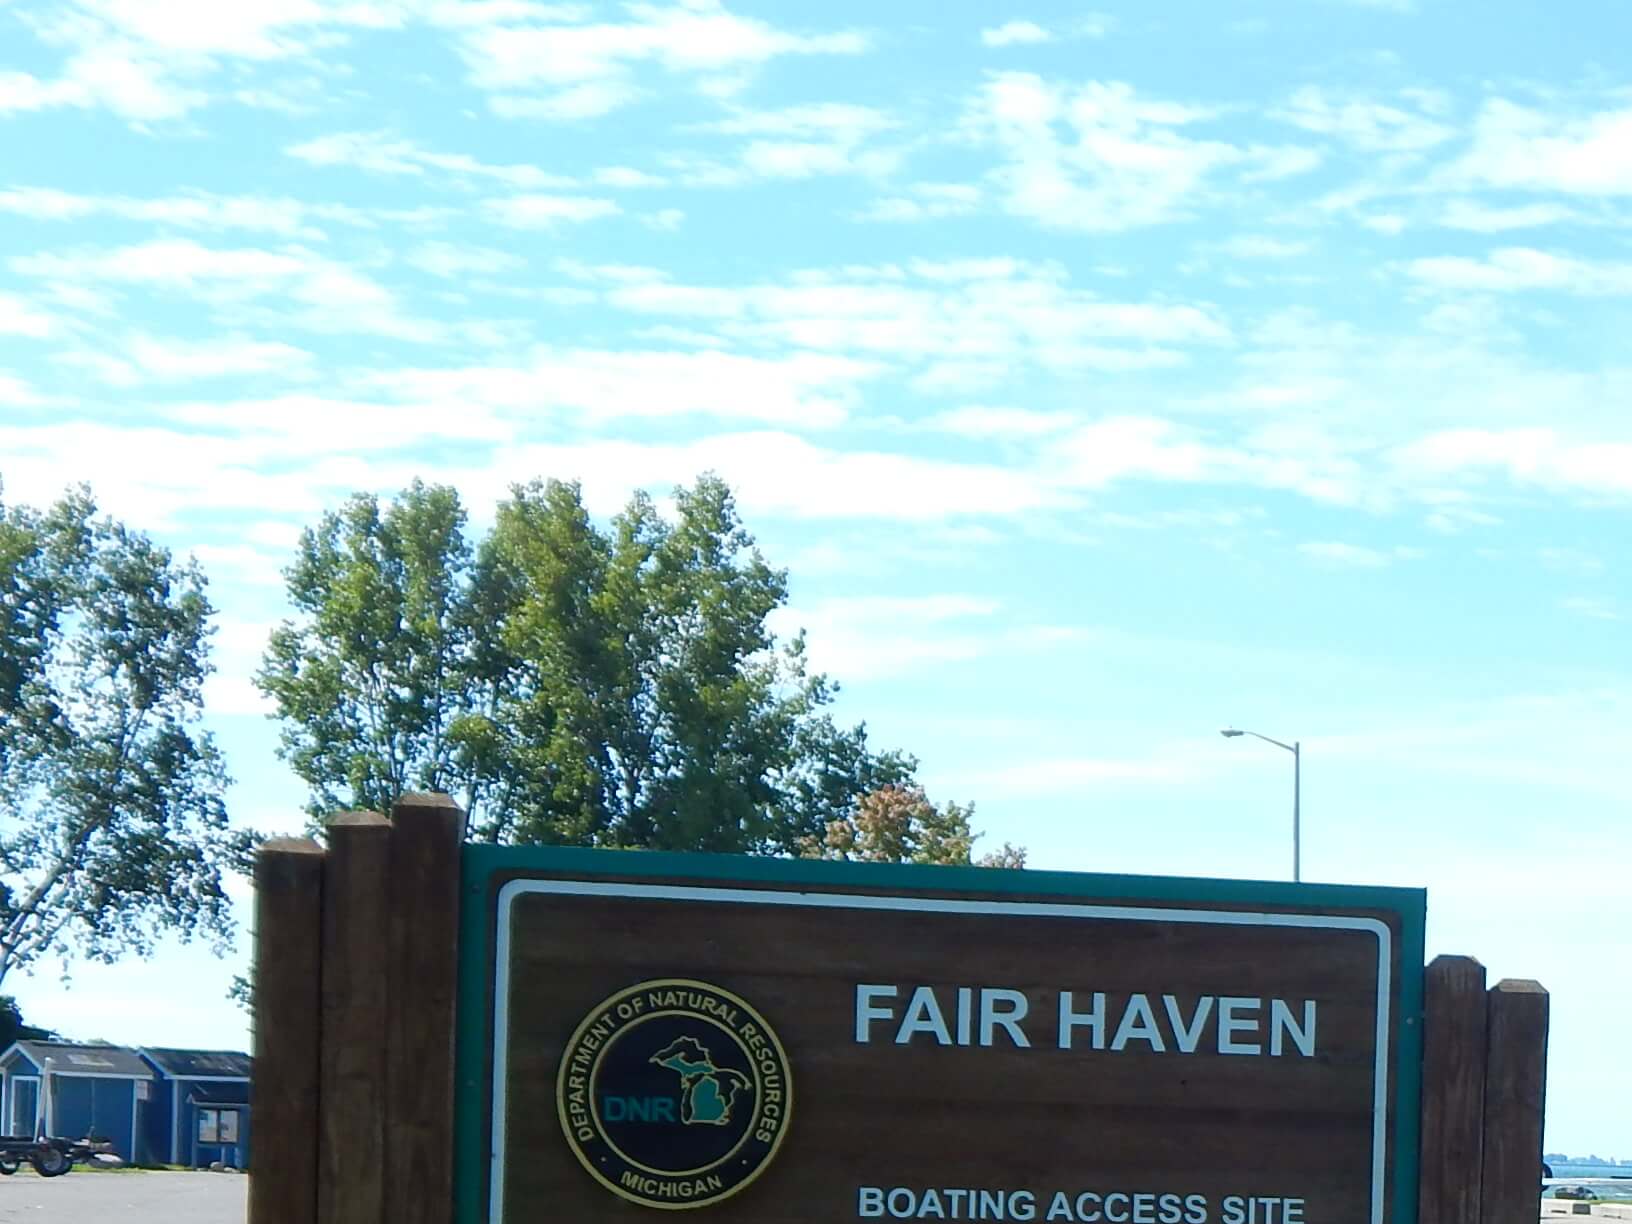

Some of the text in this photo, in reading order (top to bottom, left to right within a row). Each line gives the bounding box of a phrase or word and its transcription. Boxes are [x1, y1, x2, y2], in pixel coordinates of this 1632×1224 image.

[855, 984, 1316, 1058] FAIR HAVEN
[568, 990, 781, 1144] DEPARTMENT OF NATURAL RESOURCES
[604, 1096, 676, 1122] DNR
[620, 1170, 723, 1198] MICHIGAN
[858, 1187, 1036, 1221] BOATING
